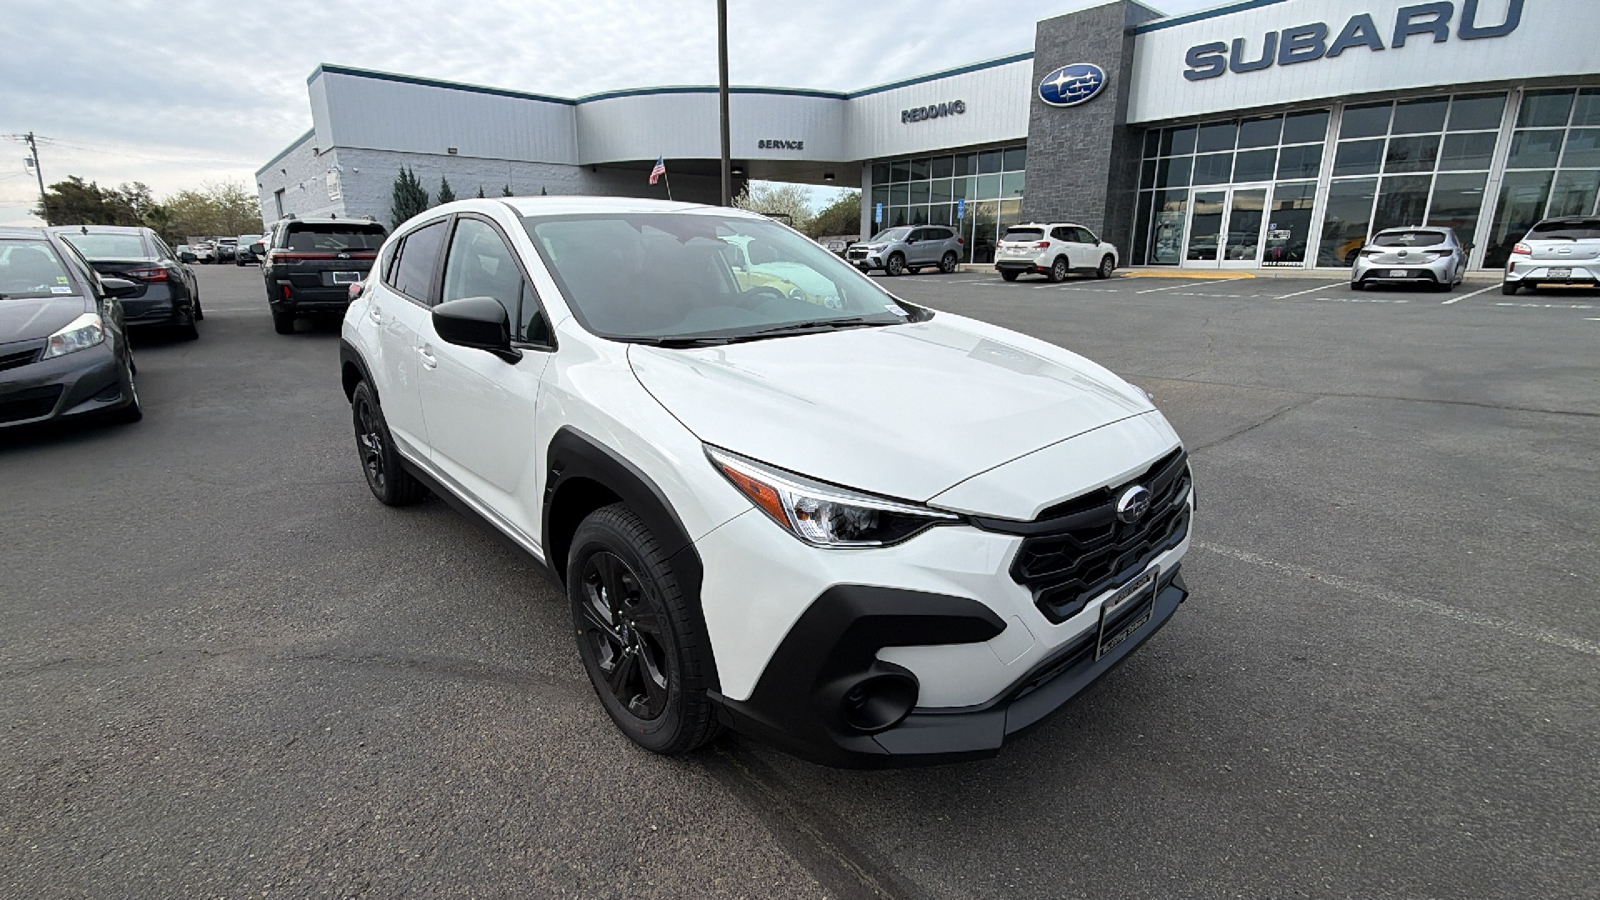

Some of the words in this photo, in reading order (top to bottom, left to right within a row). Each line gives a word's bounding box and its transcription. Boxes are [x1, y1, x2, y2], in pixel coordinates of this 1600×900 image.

[1183, 0, 1525, 82] SUBARU
[901, 99, 966, 124] REDDING
[758, 139, 804, 150] SERVICE
